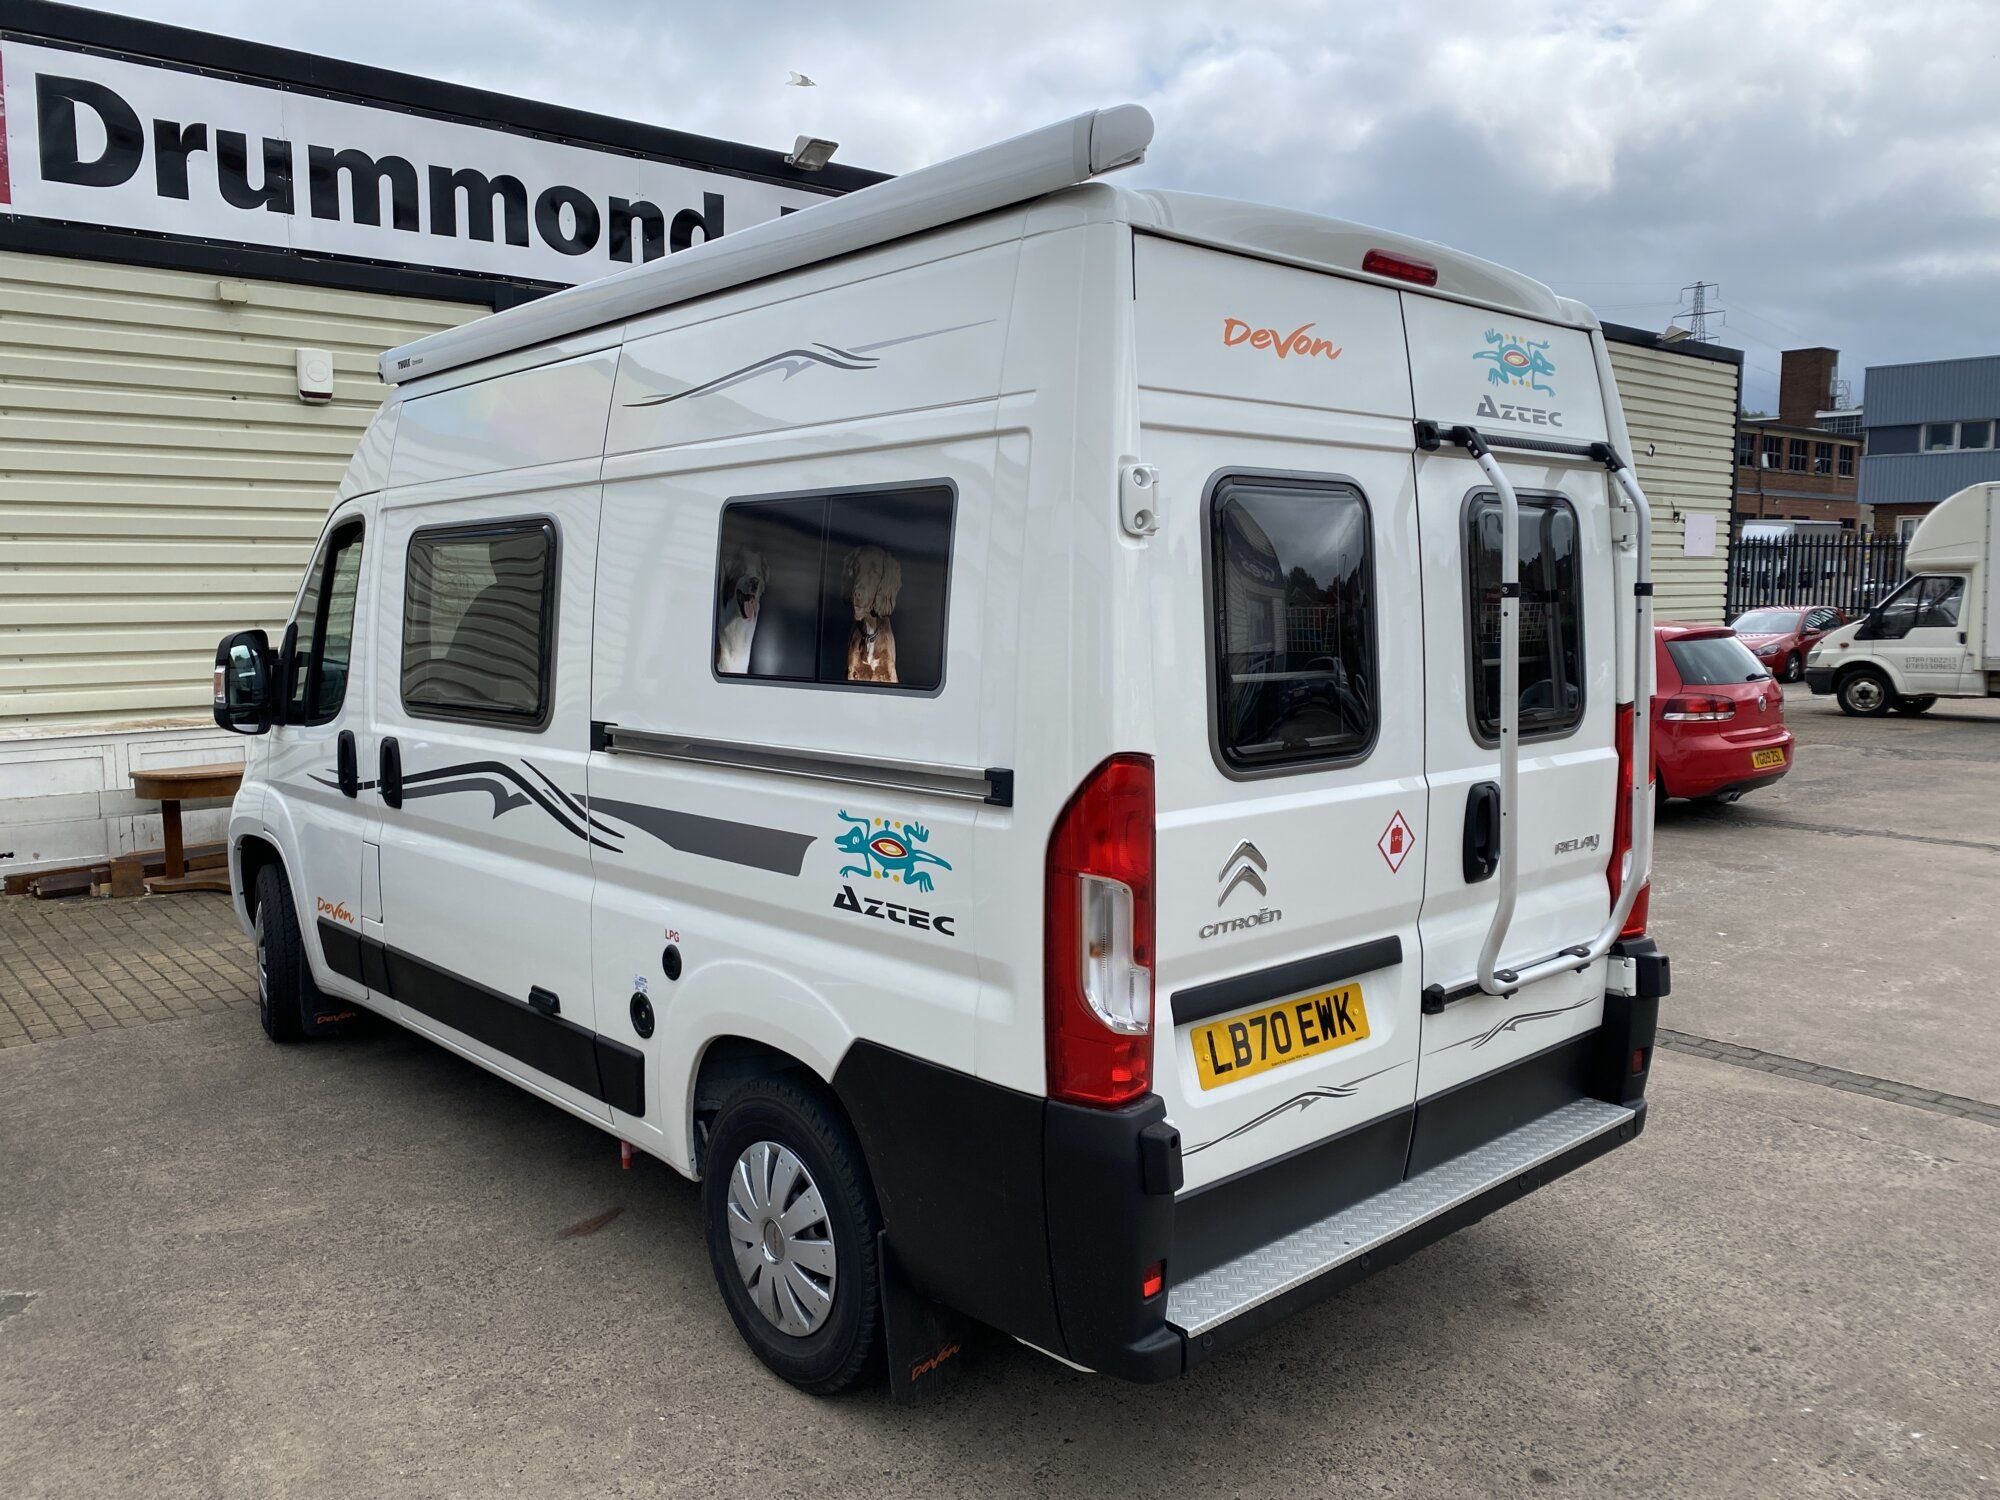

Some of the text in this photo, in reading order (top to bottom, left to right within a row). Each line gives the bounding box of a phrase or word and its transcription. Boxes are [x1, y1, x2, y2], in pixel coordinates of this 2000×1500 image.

[35, 72, 725, 264] Drummond
[664, 928, 680, 943] LPG
[1206, 990, 1357, 1075] LB70 EWK
